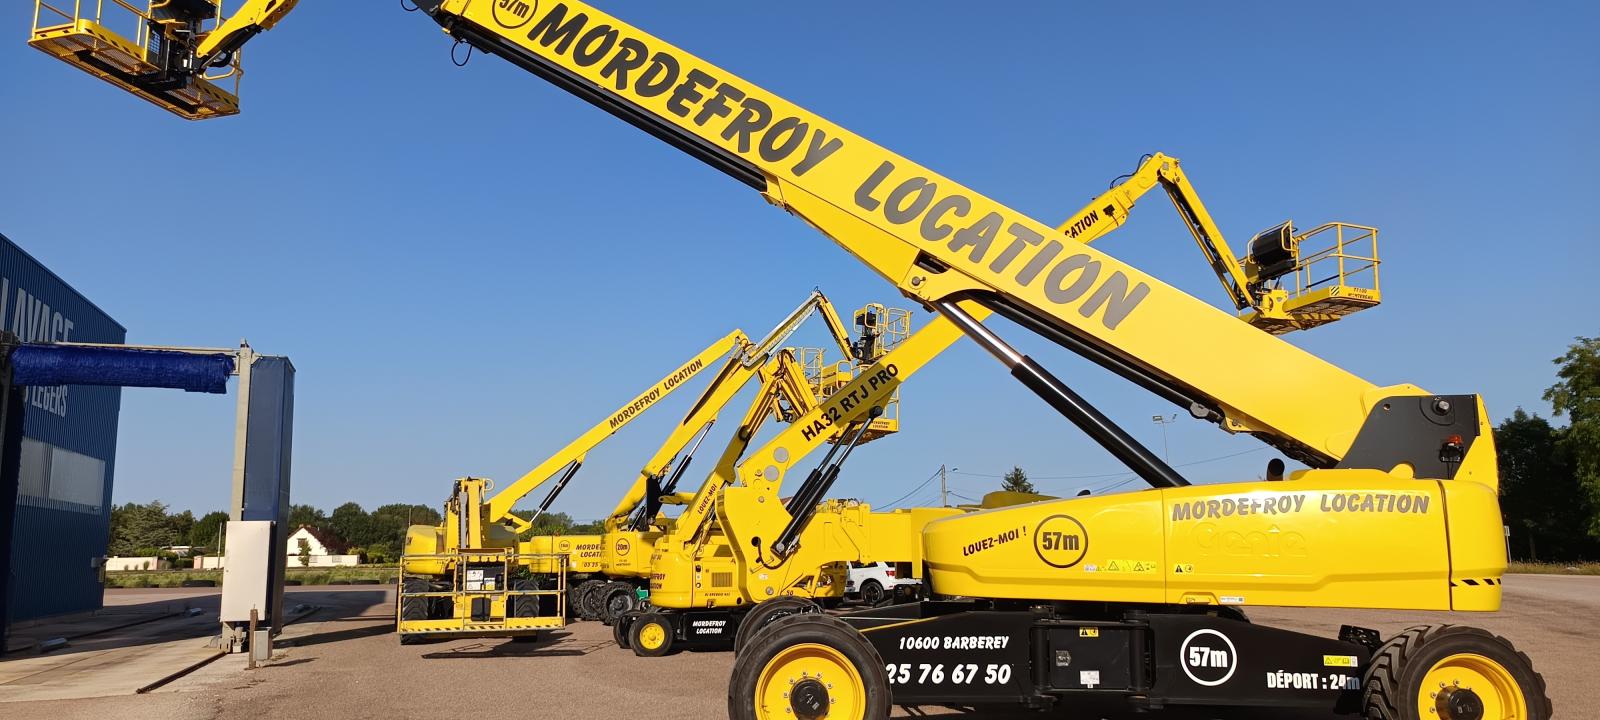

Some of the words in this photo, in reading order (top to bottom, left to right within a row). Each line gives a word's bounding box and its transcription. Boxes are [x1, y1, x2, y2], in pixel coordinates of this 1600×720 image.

[527, 3, 844, 177] MORDEFROY
[854, 160, 1151, 330] LOCATION
[609, 387, 660, 429] MORDEFROY
[663, 359, 703, 391] LOCATION
[801, 407, 841, 441] HA32
[840, 390, 869, 412] RTJ
[868, 363, 898, 391] PRO
[697, 483, 717, 515] LOUEZ-MOI
[1171, 494, 1306, 522] MORDEFROY
[1320, 493, 1430, 514] LOCATION
[963, 528, 1019, 557] LOUEZ-MOI
[1042, 531, 1079, 551] 57m
[899, 636, 940, 650] 10600
[943, 635, 1009, 650] BARBEREY
[1188, 646, 1228, 668] 57m
[885, 663, 912, 684] 25
[918, 663, 945, 684] 76
[951, 663, 979, 684] 67
[984, 663, 1012, 684] 50
[1266, 670, 1318, 689] DÉPORT
[1330, 674, 1361, 690] 24m
